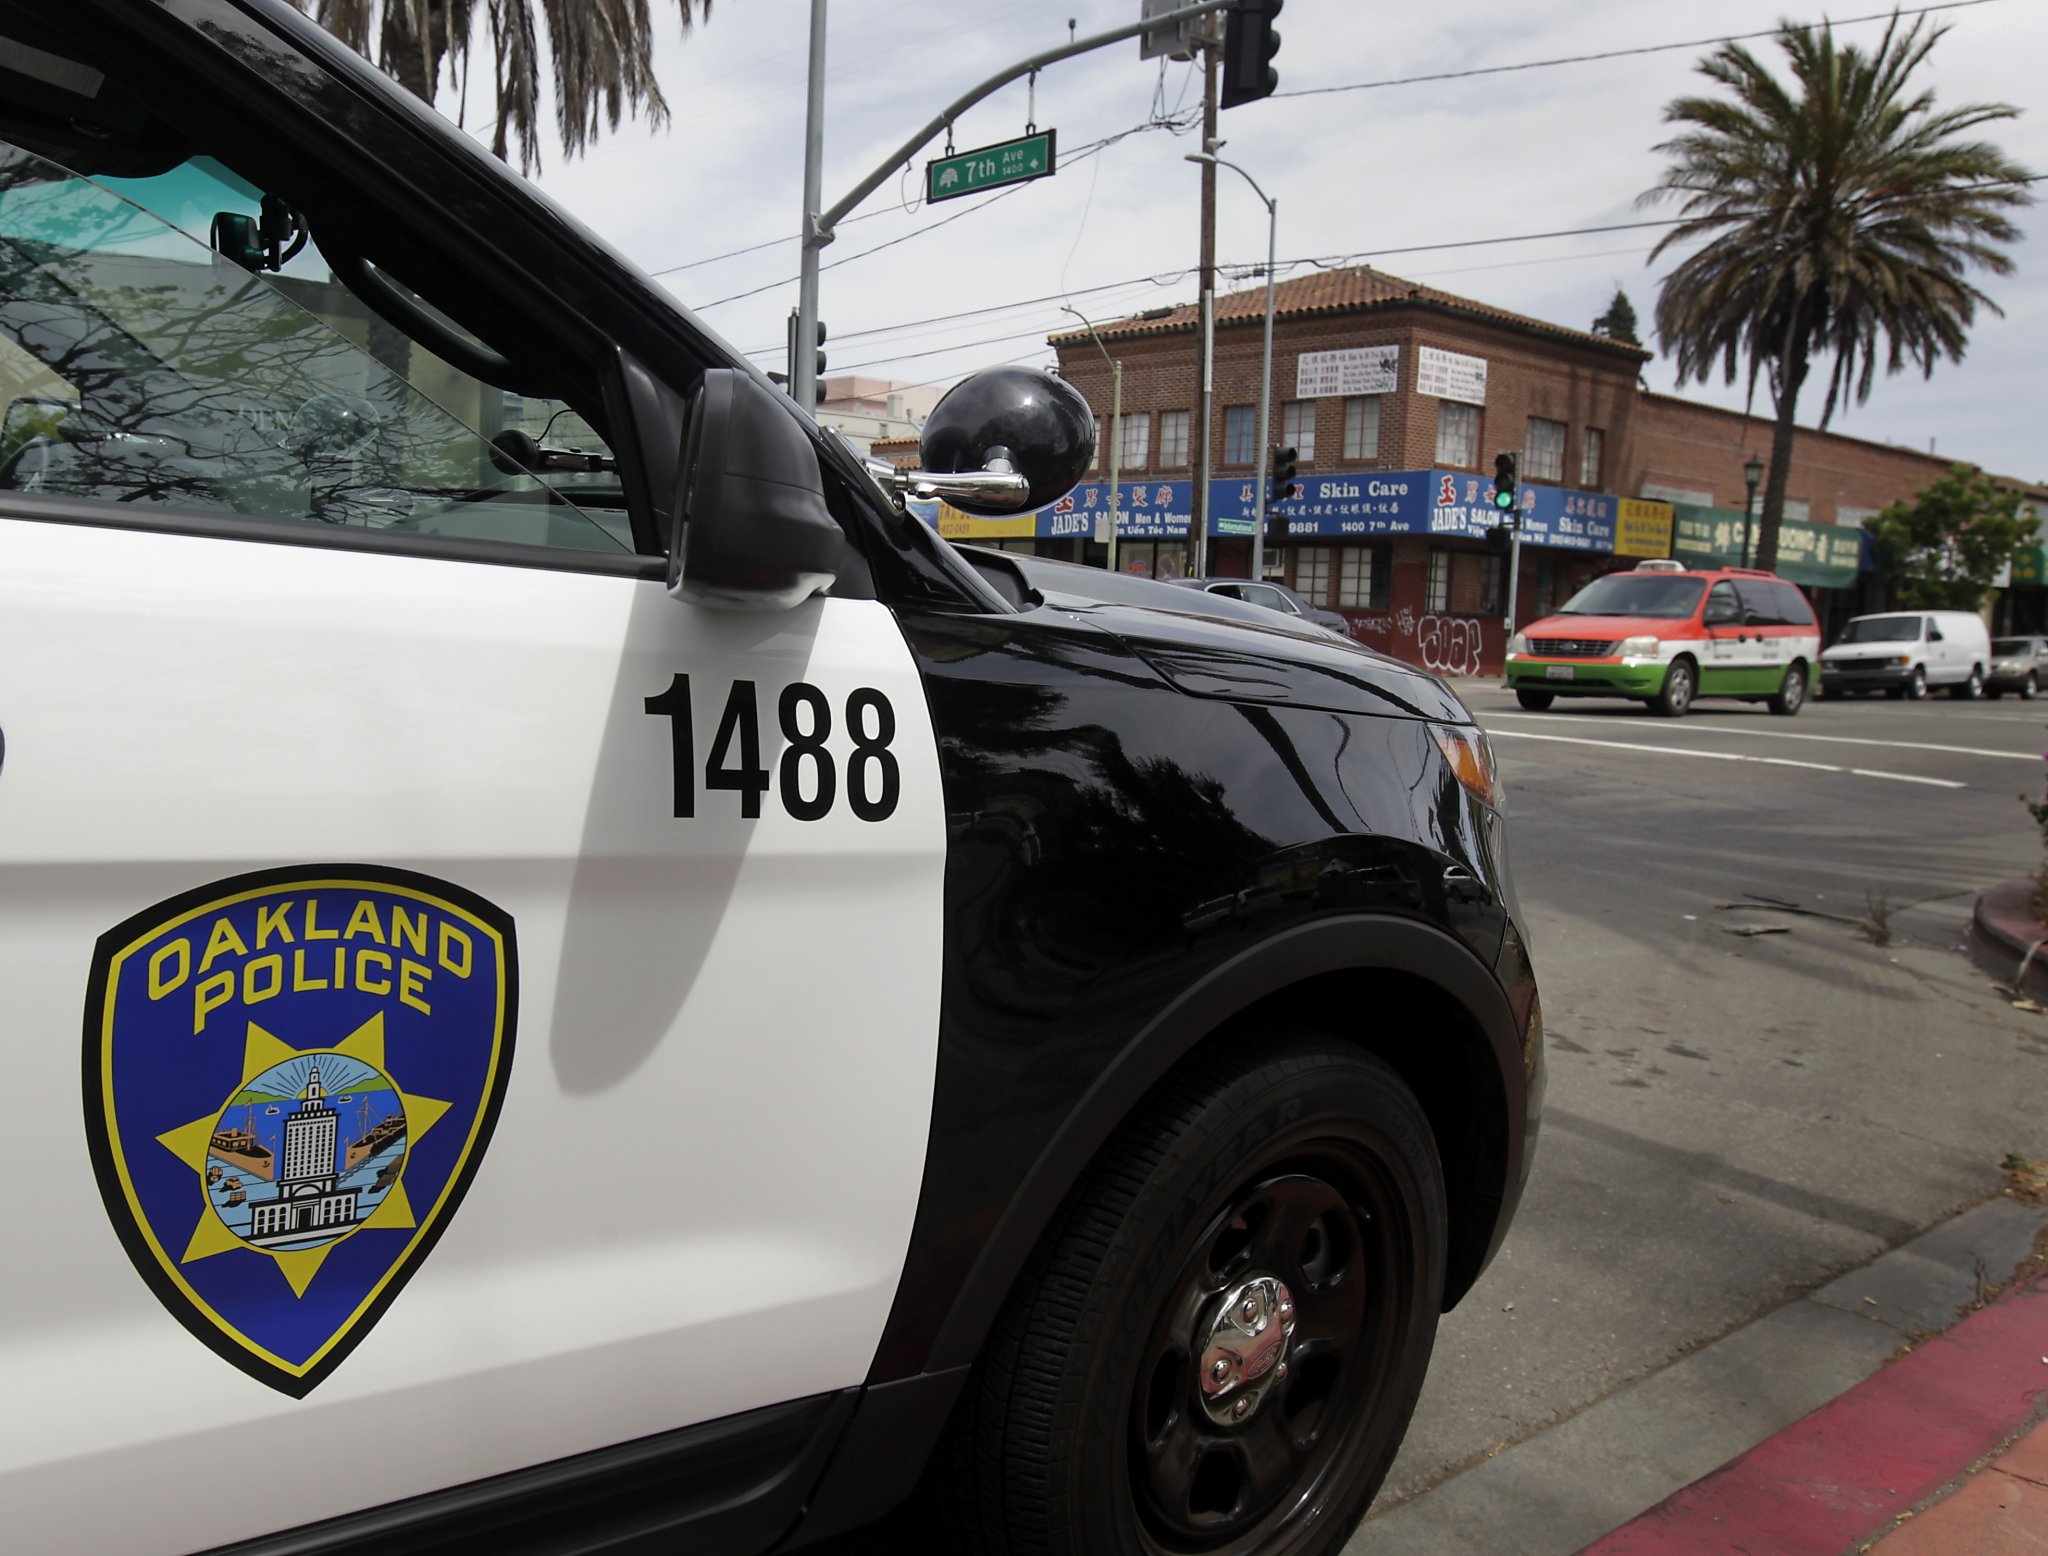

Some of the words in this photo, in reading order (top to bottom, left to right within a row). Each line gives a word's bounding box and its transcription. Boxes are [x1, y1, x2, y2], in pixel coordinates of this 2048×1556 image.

[965, 159, 996, 183] 7th
[1002, 149, 1024, 164] Ave
[1002, 164, 1024, 176] 1400
[1319, 482, 1360, 499] Skin
[1368, 480, 1408, 496] Care
[1051, 511, 1089, 536] JADE'S
[1095, 511, 1130, 525] SAON
[1135, 513, 1152, 524] Men
[1154, 512, 1161, 524] &
[1167, 525, 1187, 534] Nam
[1341, 521, 1365, 532] 1400
[1369, 520, 1386, 531] 7th
[1390, 520, 1410, 531] Ave
[1431, 506, 1467, 532] JADE'S
[1470, 508, 1501, 529] SALON
[1558, 516, 1584, 534] Skin
[644, 672, 900, 823] 1488
[147, 899, 473, 1001] OAKLAND
[193, 946, 433, 1036] POLICE
